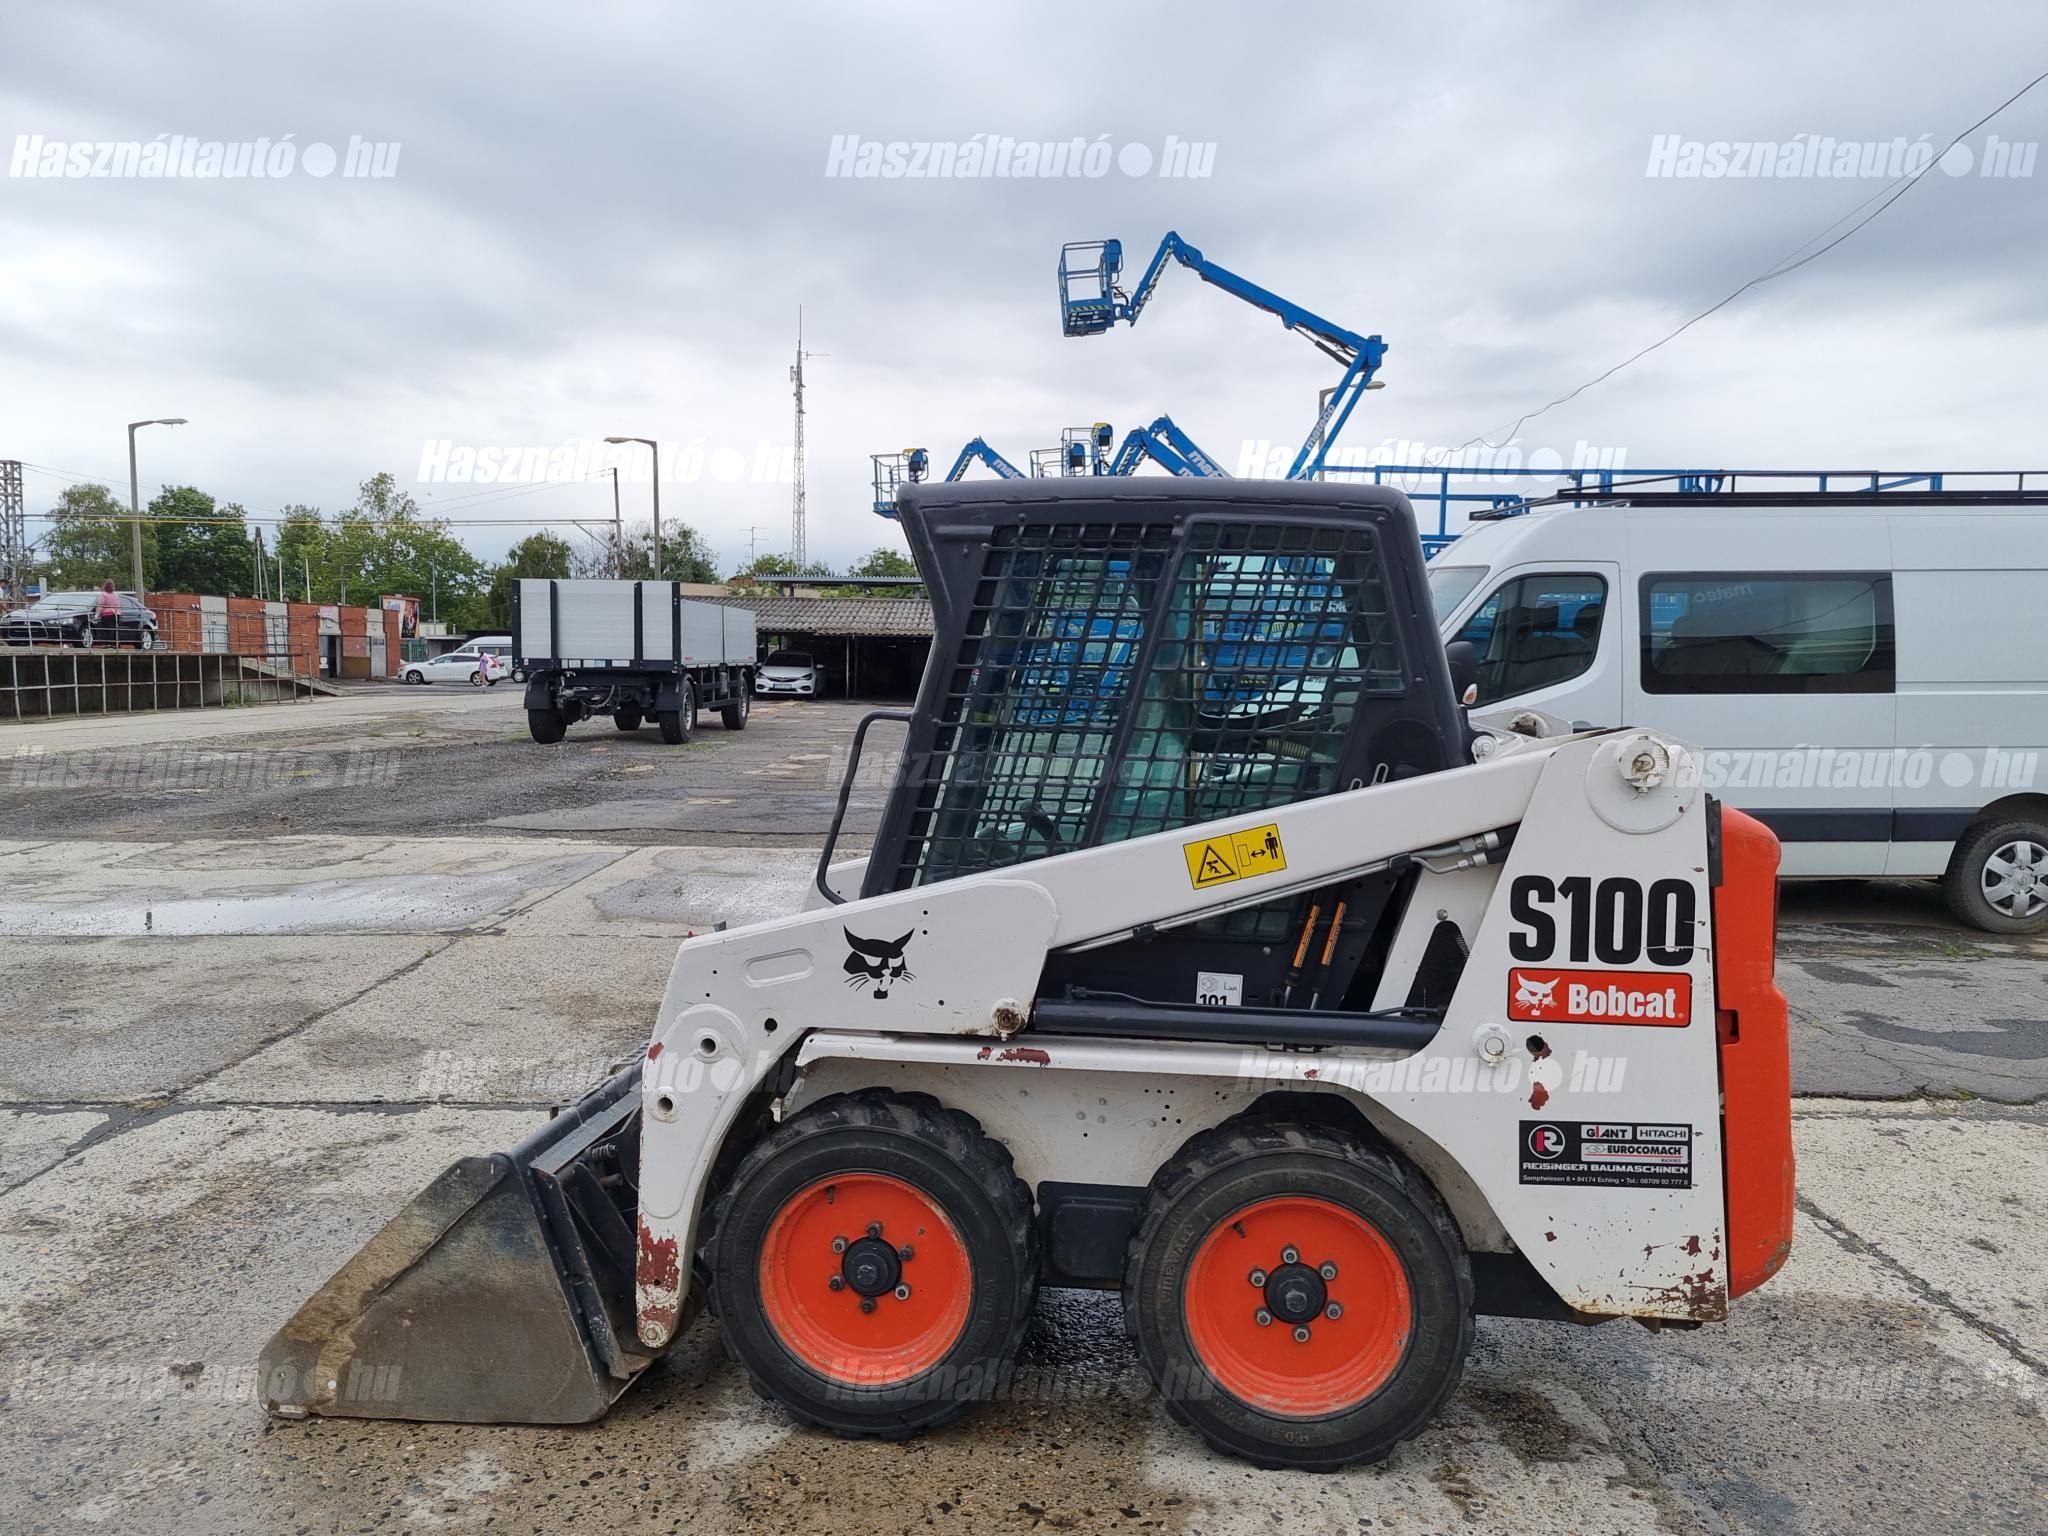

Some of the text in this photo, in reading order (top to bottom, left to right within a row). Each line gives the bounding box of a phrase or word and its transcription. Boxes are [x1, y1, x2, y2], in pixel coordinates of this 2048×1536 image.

[1509, 875, 1696, 967] S100
[1568, 983, 1676, 1018] Bobcat
[1586, 1126, 1628, 1139] GIANT
[1639, 1129, 1687, 1139] HITACHI
[1607, 1144, 1682, 1156] EUROCOMACH
[1597, 1176, 1620, 1185] Eching
